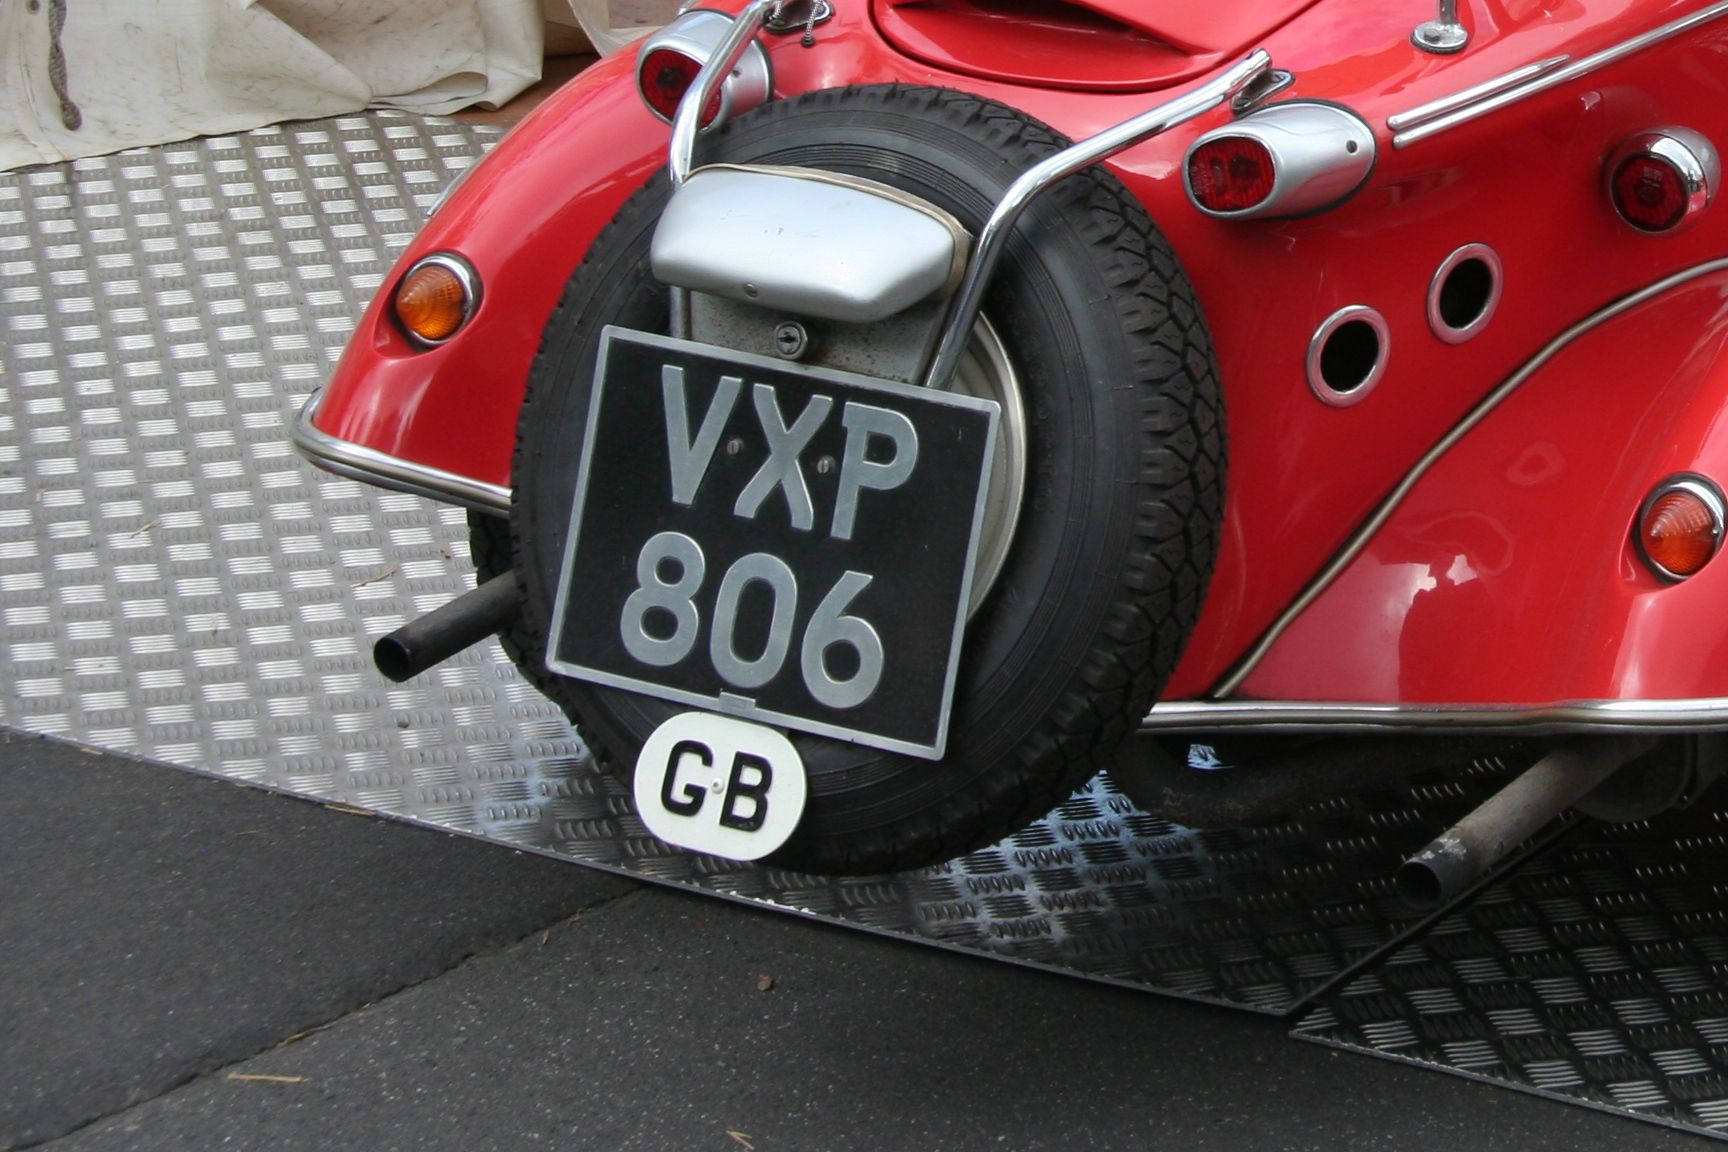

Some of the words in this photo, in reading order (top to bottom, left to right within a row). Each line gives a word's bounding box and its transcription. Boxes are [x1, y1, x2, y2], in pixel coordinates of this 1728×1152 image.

[662, 364, 919, 540] VXP
[620, 531, 884, 709] 806
[660, 739, 774, 832] GB
